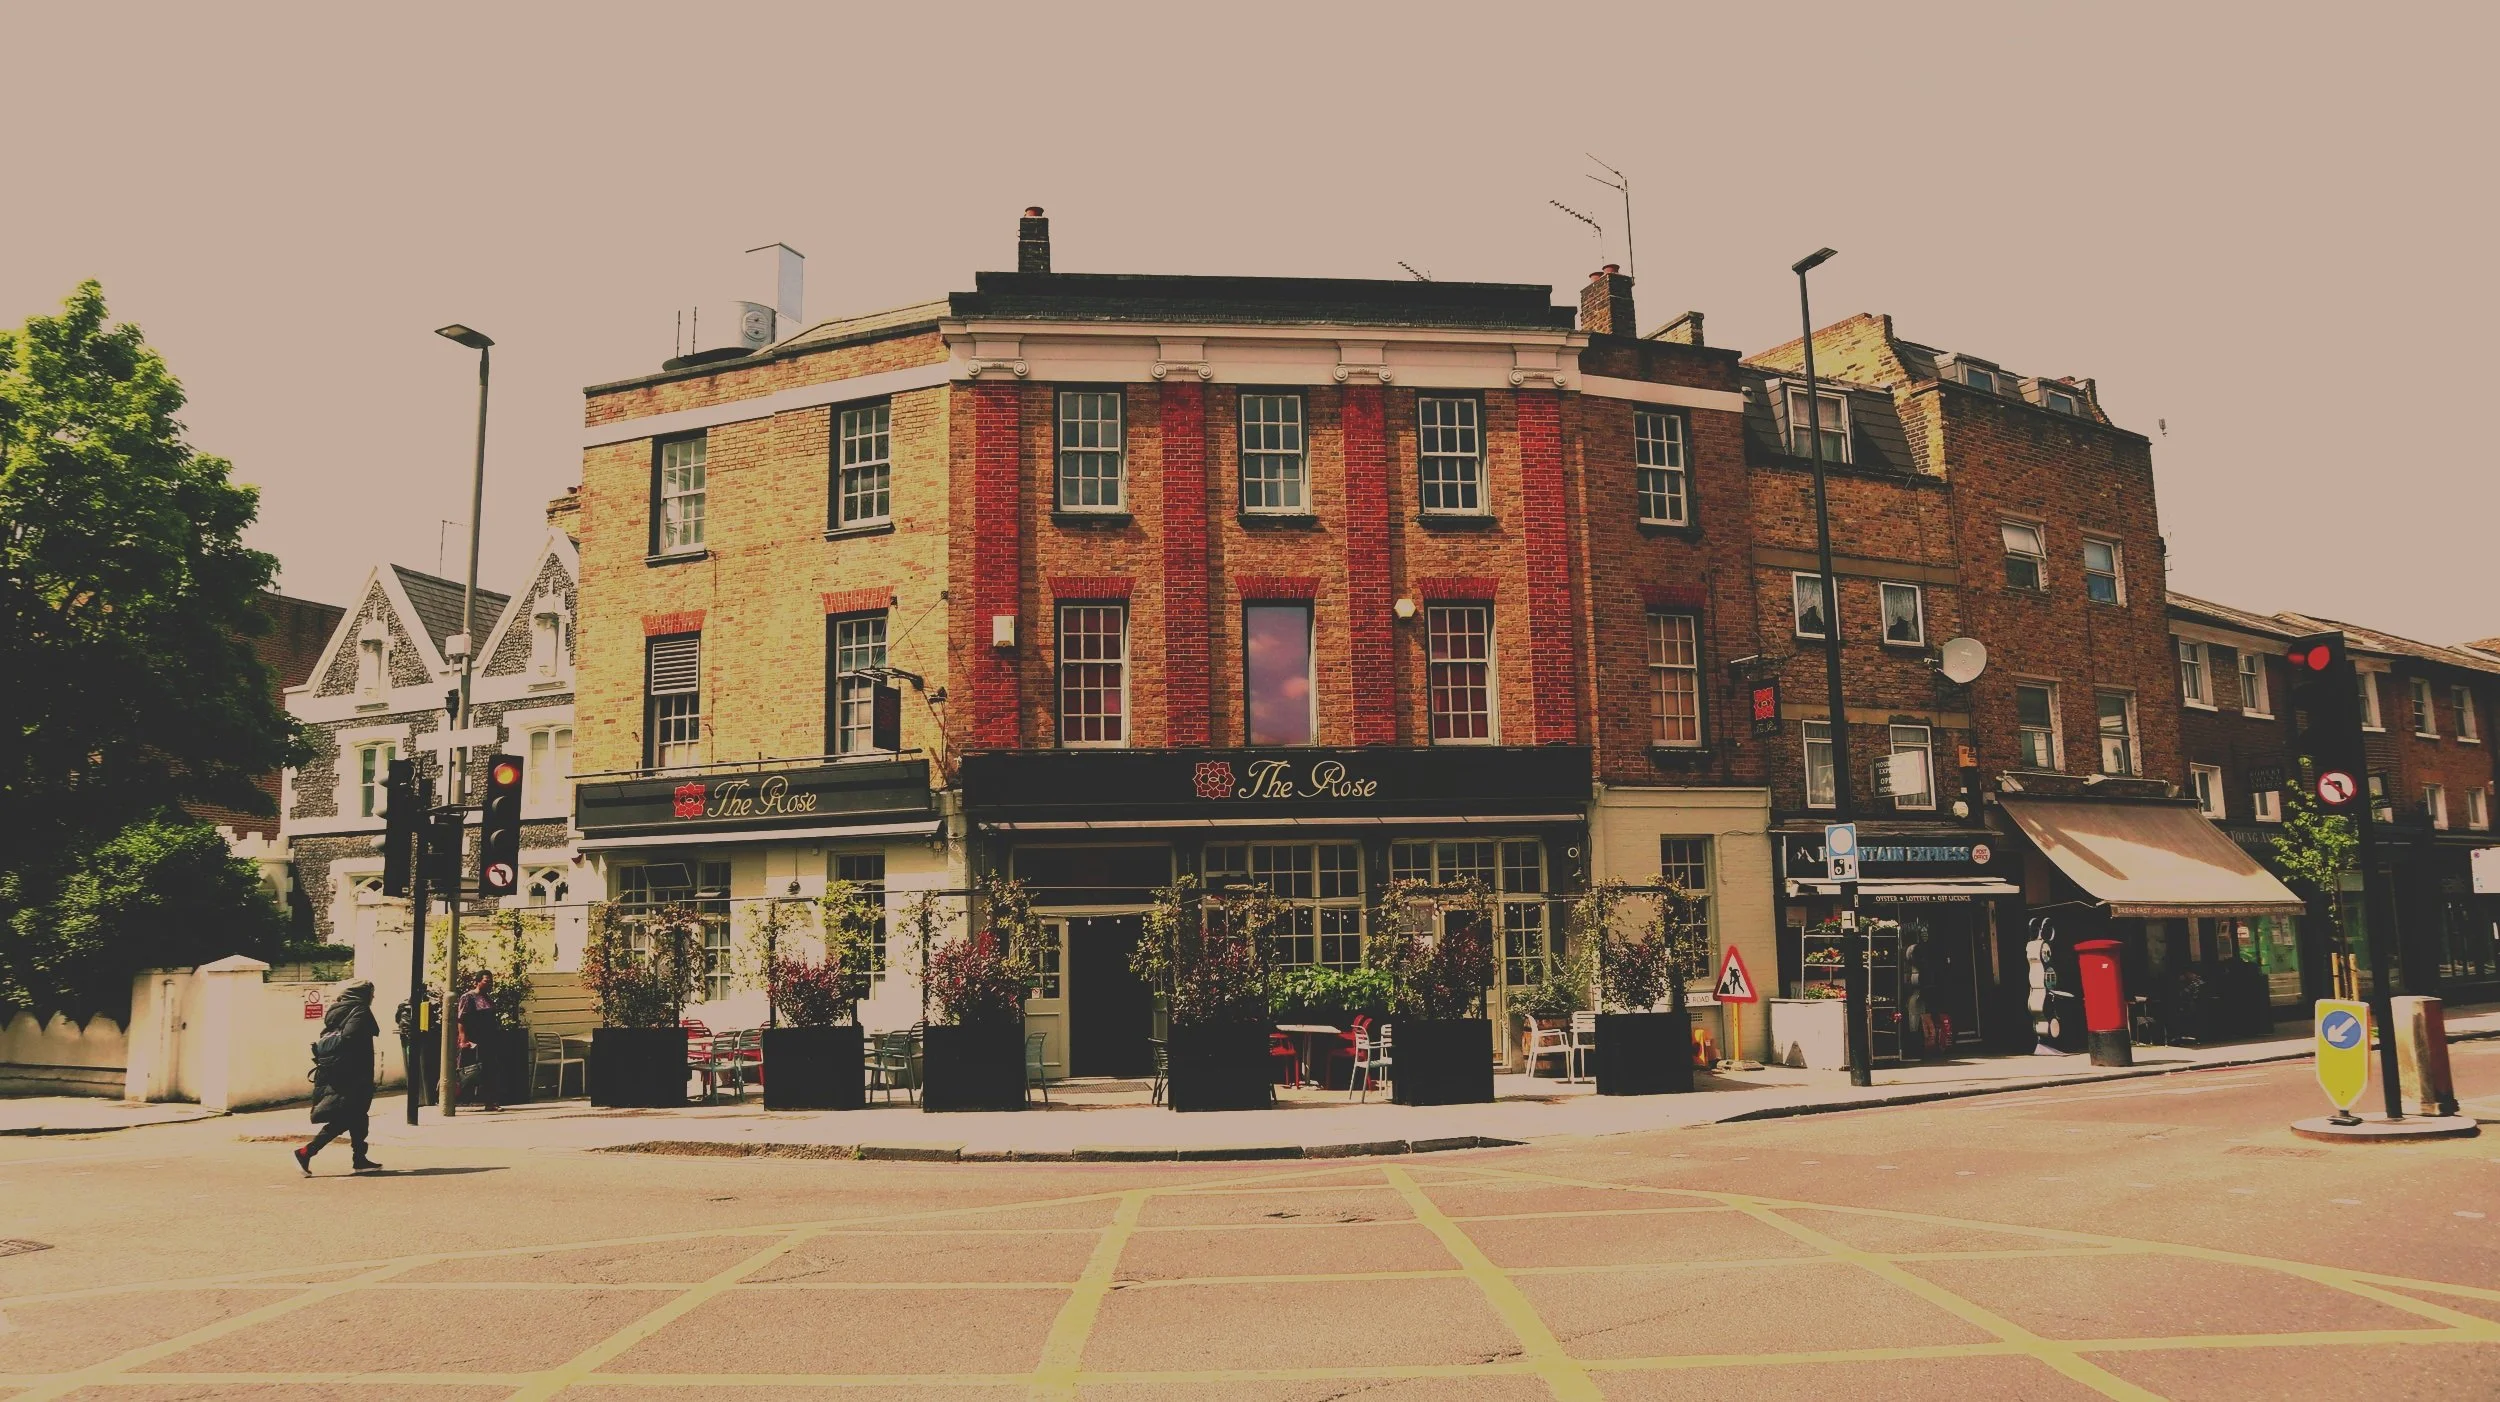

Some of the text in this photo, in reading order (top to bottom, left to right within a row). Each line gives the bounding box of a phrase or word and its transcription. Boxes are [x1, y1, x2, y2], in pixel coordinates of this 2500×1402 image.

[1238, 760, 1378, 799] The Rose
[707, 775, 817, 818] The Rose
[1905, 846, 1969, 861] EXPRESS
[2118, 906, 2151, 914] BREAKFAST
[1692, 995, 1710, 1003] ROAD
